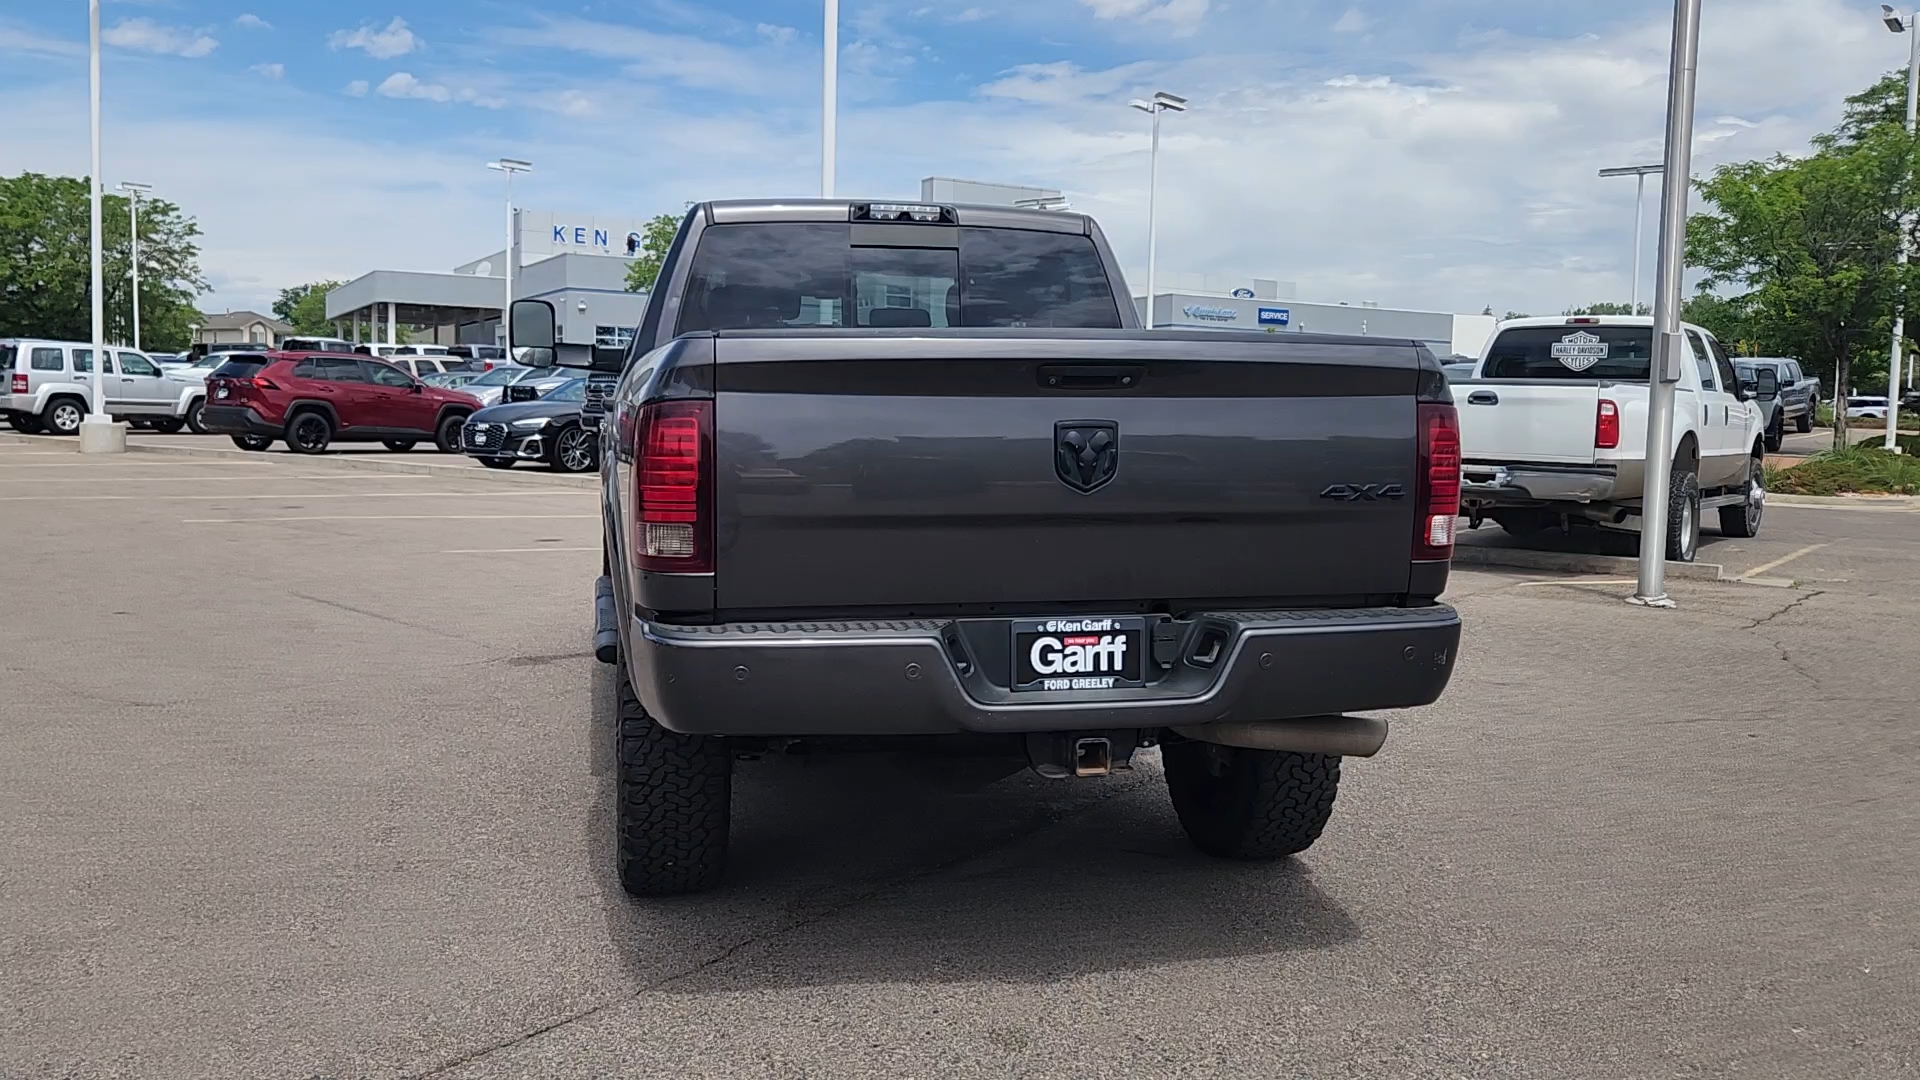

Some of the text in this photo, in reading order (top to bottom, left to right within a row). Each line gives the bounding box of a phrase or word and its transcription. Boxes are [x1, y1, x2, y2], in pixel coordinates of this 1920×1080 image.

[553, 225, 608, 247] KEN
[1260, 311, 1289, 321] SERVICE
[1567, 335, 1595, 344] MOTOR
[1555, 346, 1605, 355] HARLEY-DAVIDSON
[1564, 356, 1592, 368] CYCLES
[1057, 619, 1112, 632] Ken Garff
[1030, 635, 1127, 675] Garff
[1044, 678, 1115, 690] FORD GREELEY
